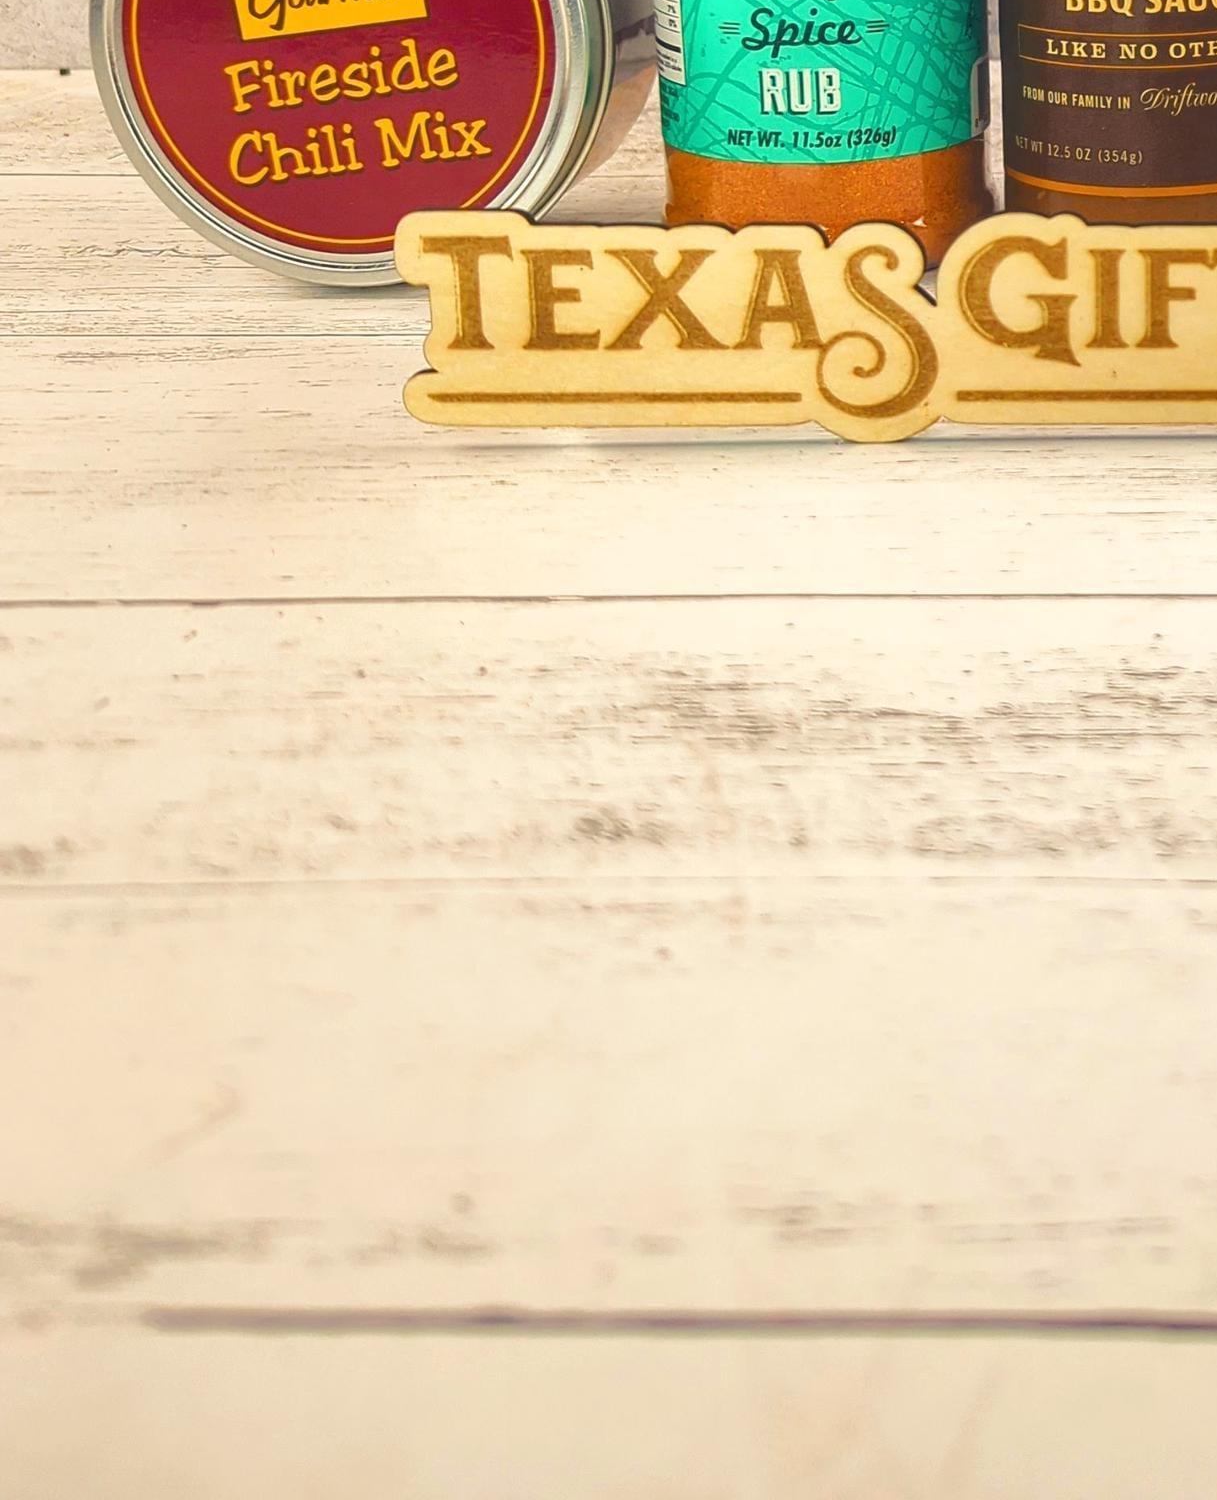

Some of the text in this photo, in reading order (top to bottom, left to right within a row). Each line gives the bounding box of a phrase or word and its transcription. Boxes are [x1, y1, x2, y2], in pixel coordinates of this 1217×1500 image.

[741, 8, 863, 56] Spice
[1045, 38, 1107, 60] LIKE
[1118, 41, 1158, 60] NO
[225, 39, 459, 114] Fireside
[759, 68, 843, 116] RUB
[1022, 85, 1045, 101] FROM
[1047, 92, 1068, 105] OUR
[1072, 94, 1112, 109] FAMILY
[1117, 96, 1131, 109] IN
[229, 111, 491, 186] Chili Mix
[727, 126, 897, 149] NET WT. 11.5oz (326g)
[1047, 143, 1071, 158] 12.5
[1075, 147, 1091, 161] OZ
[1098, 149, 1143, 165] (354g)
[419, 235, 938, 418] TEXAS
